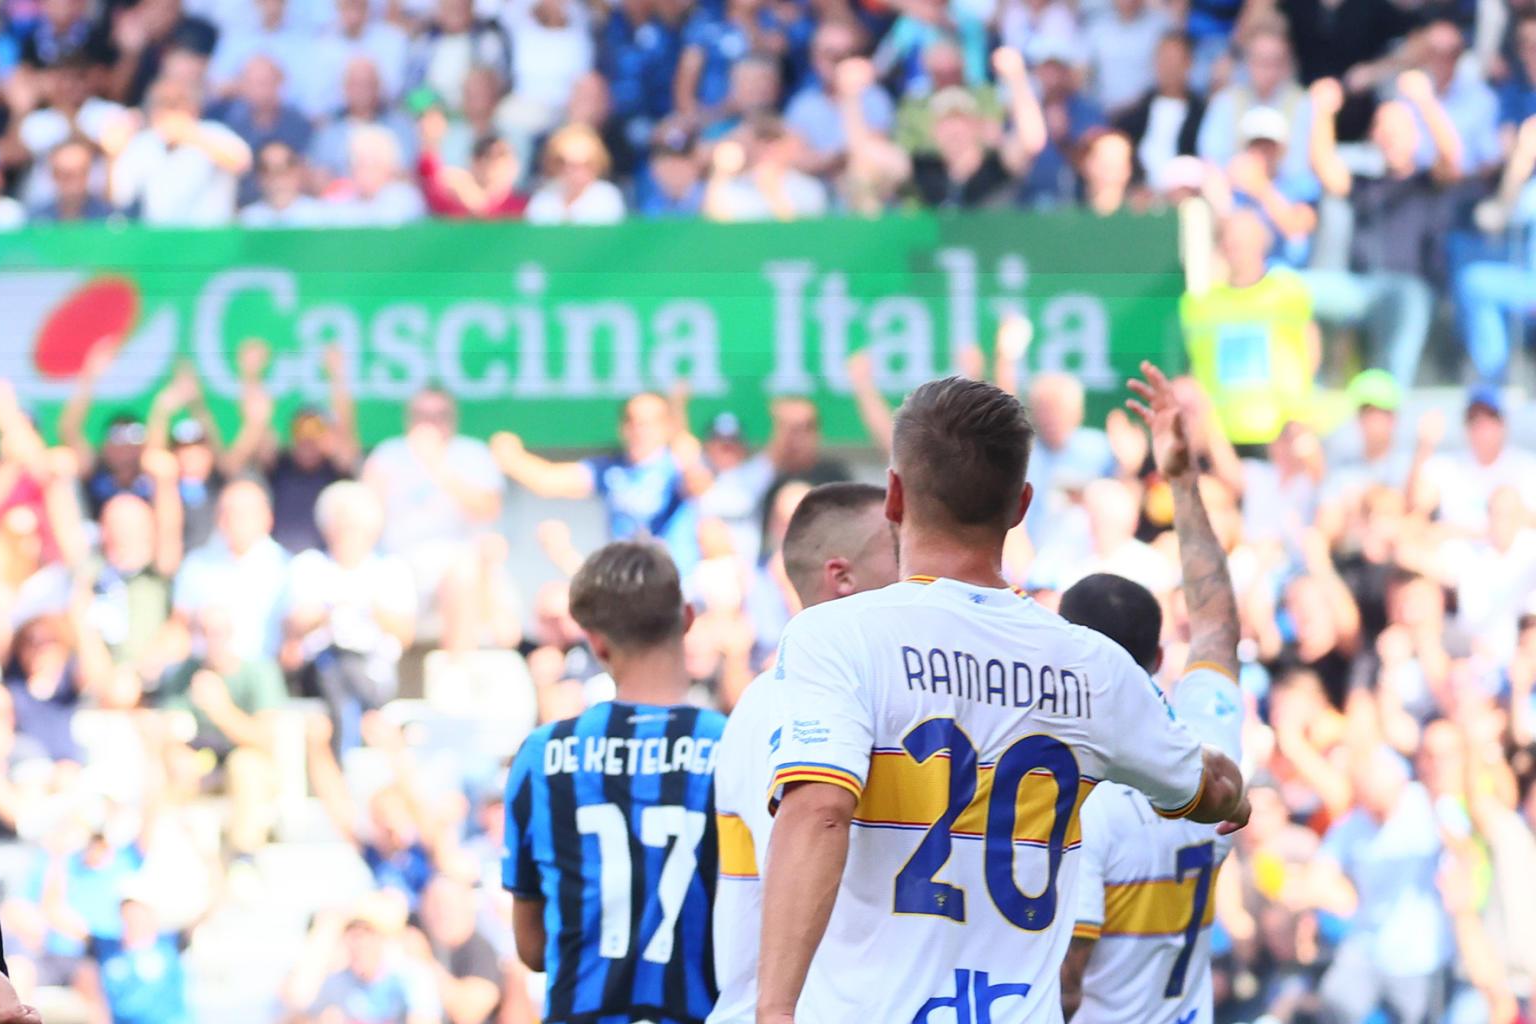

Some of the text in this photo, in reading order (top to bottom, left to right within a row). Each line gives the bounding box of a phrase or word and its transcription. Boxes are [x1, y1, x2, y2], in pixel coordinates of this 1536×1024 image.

[193, 248, 1119, 400] Cascina Italia
[544, 736, 580, 776] DE
[902, 646, 1092, 719] RAMADANI
[575, 803, 707, 965] 17
[892, 716, 1081, 933] 20
[1164, 839, 1216, 999] 7
